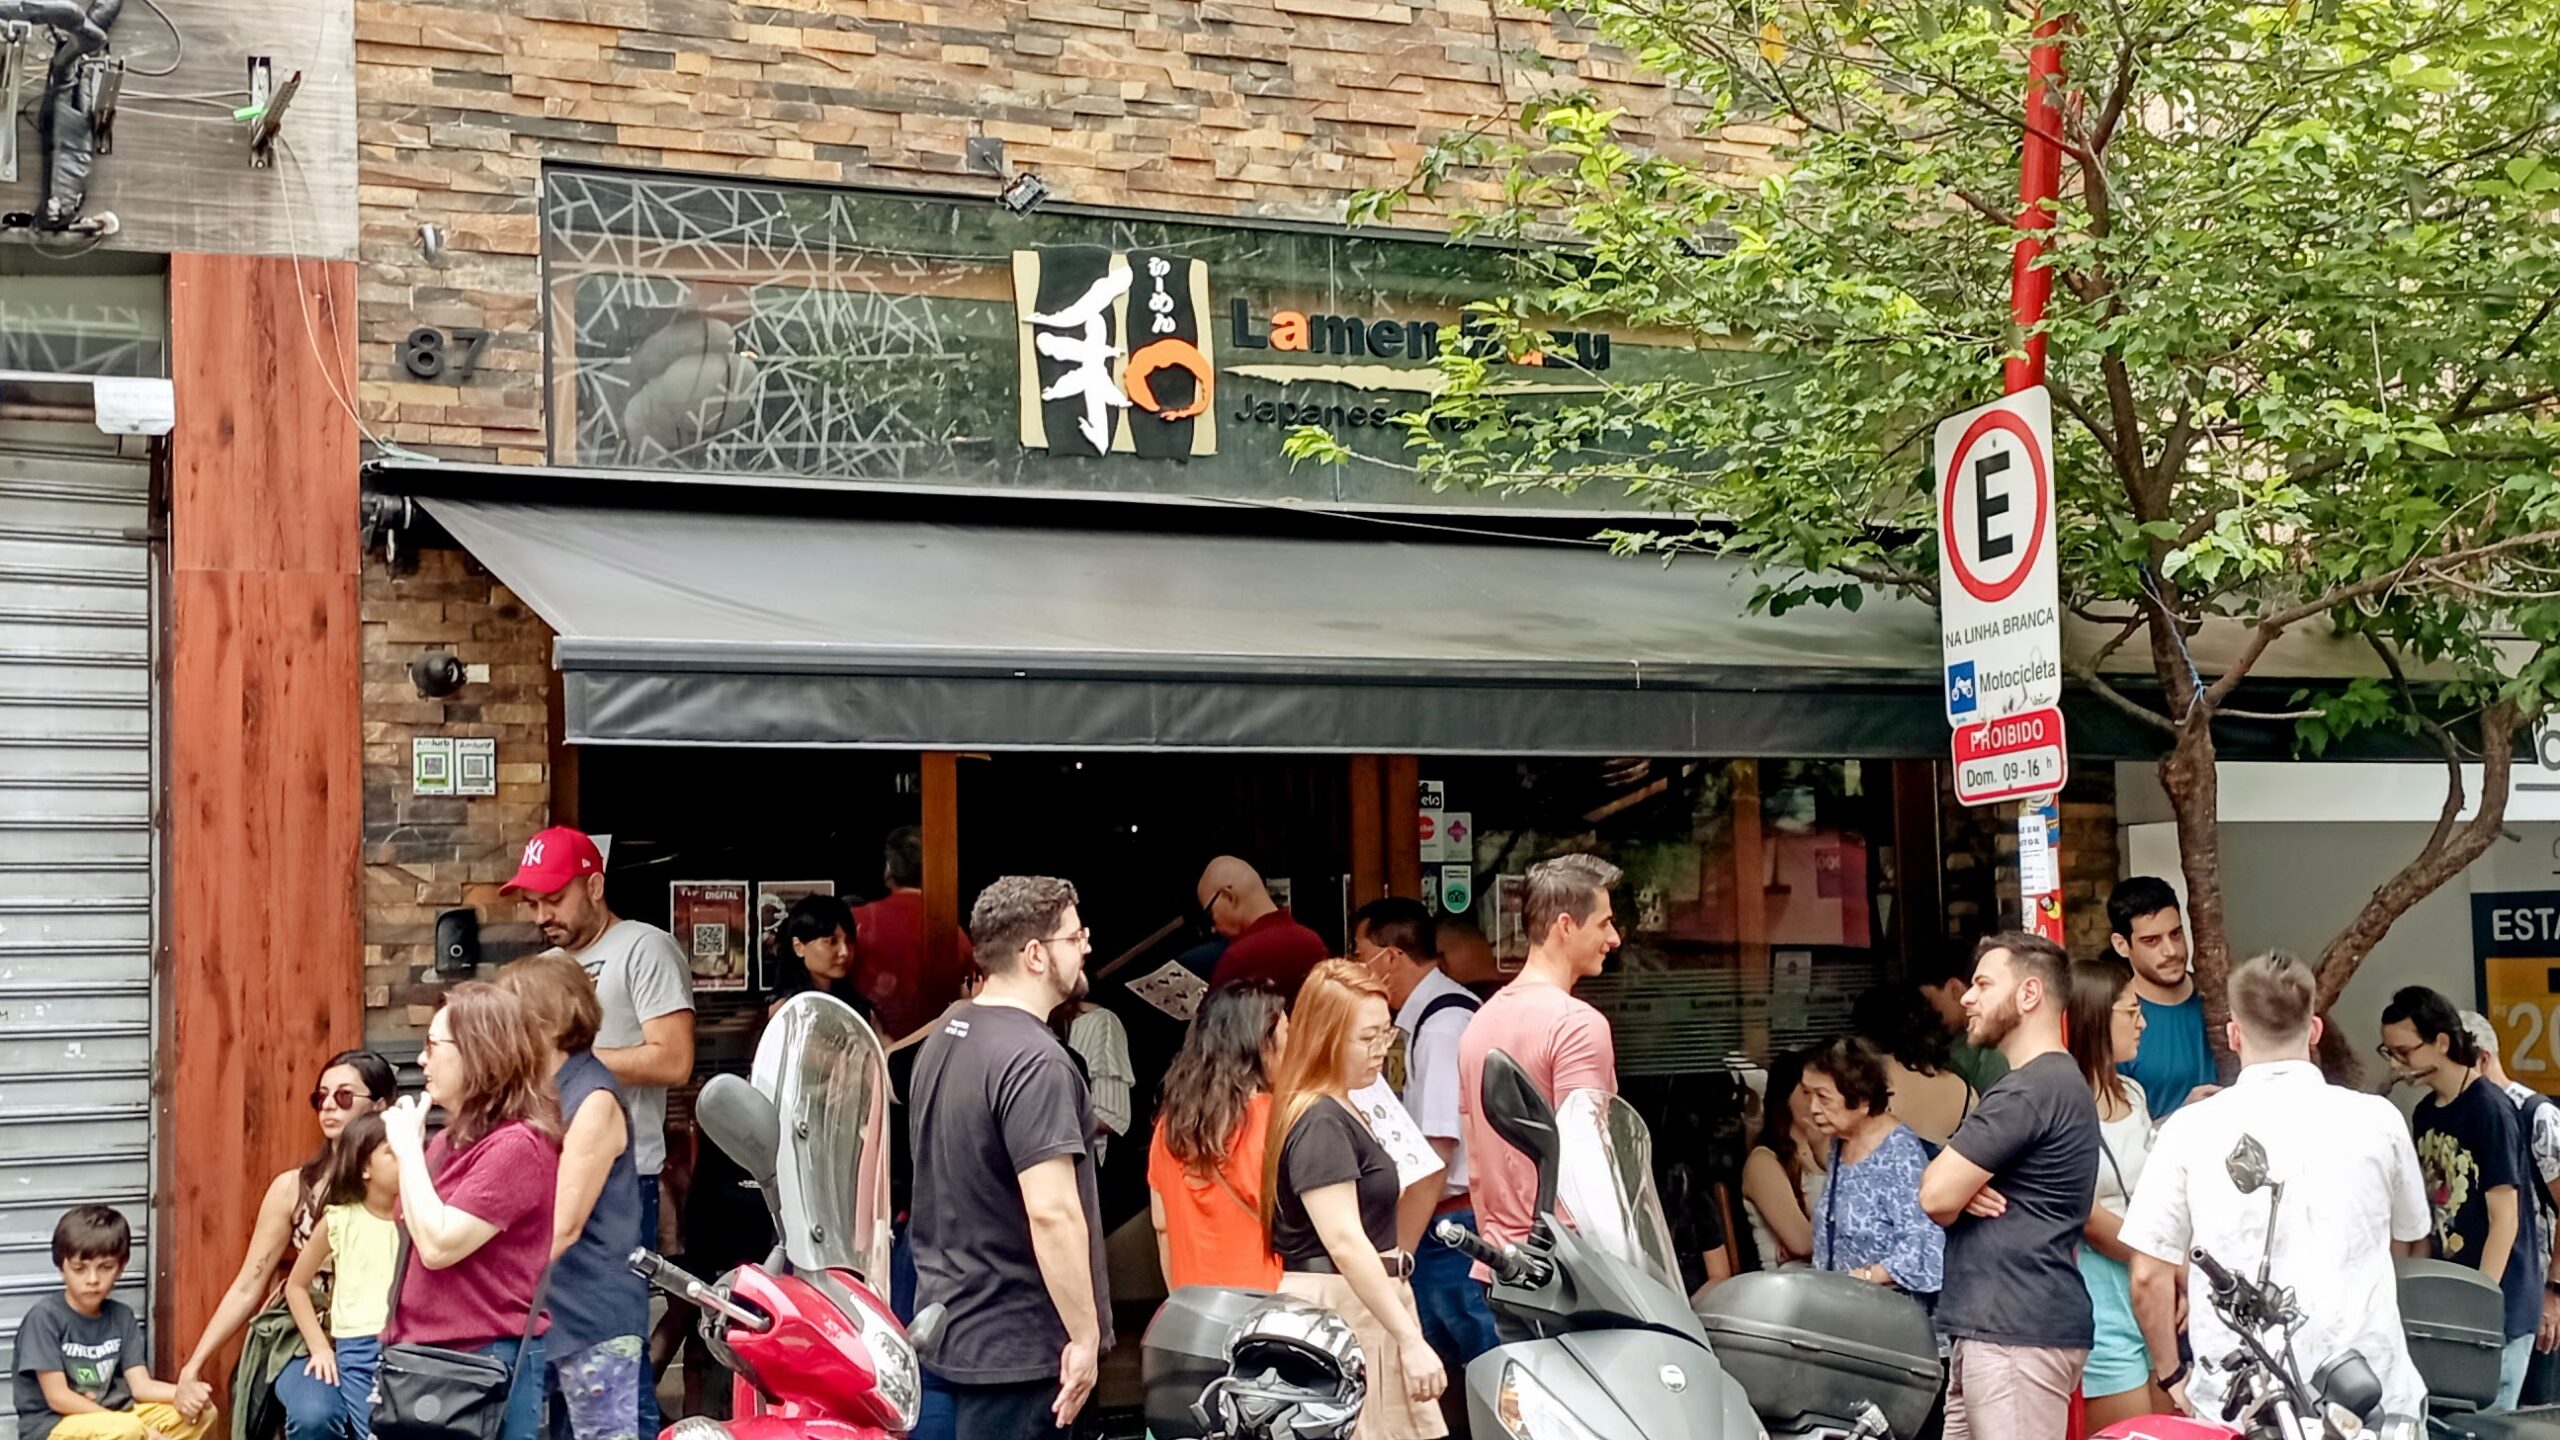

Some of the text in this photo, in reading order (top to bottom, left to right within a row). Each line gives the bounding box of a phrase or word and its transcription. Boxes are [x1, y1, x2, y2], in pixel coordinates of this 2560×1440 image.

[1231, 298, 1439, 361] Lamen
[406, 327, 491, 379] 87
[1976, 450, 2013, 562] E
[1945, 607, 2054, 648] NA LINHA BRANCA
[1980, 660, 2056, 693] Motocicleta
[1970, 718, 2044, 753] PROIBIDO
[1967, 769, 1998, 788] Dom.
[521, 838, 545, 867] NY
[705, 891, 739, 900] DIGITAL
